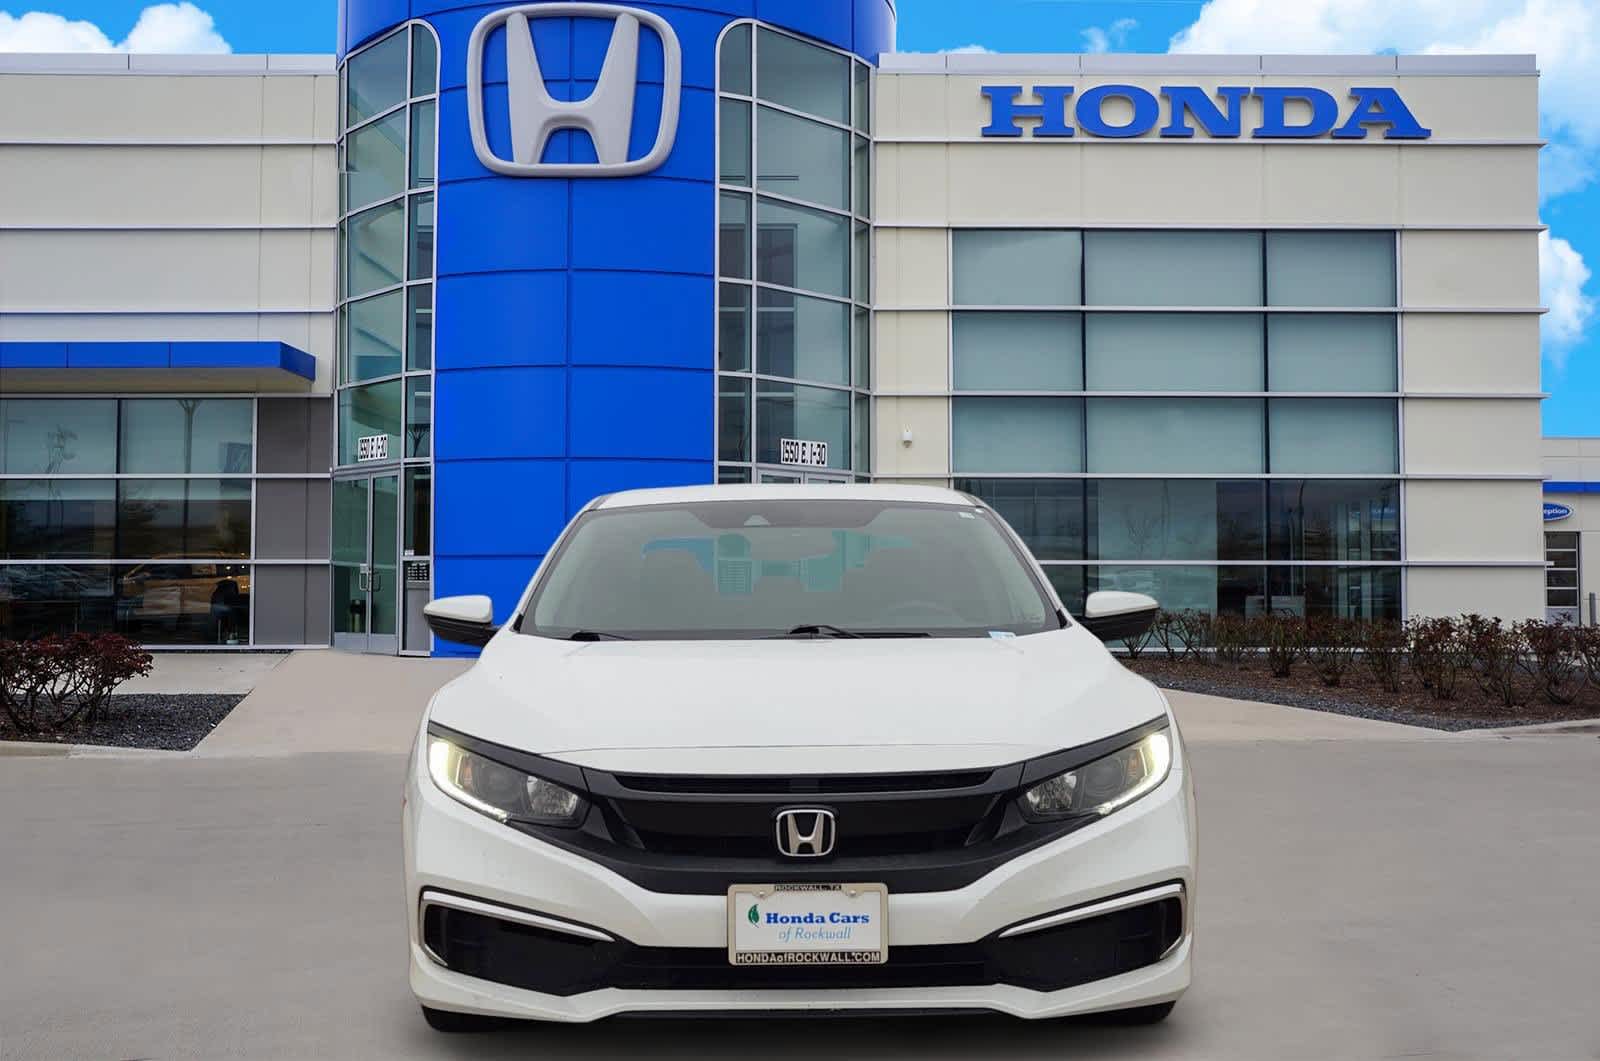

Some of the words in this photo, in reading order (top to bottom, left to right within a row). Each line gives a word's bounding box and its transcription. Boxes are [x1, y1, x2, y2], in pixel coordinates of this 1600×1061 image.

[980, 84, 1432, 139] HONDA
[782, 440, 799, 463] 1550
[810, 443, 826, 465] I-30
[766, 912, 825, 924] Honda
[829, 912, 869, 924] Cars
[779, 926, 791, 942] of
[795, 927, 851, 940] Rockwall
